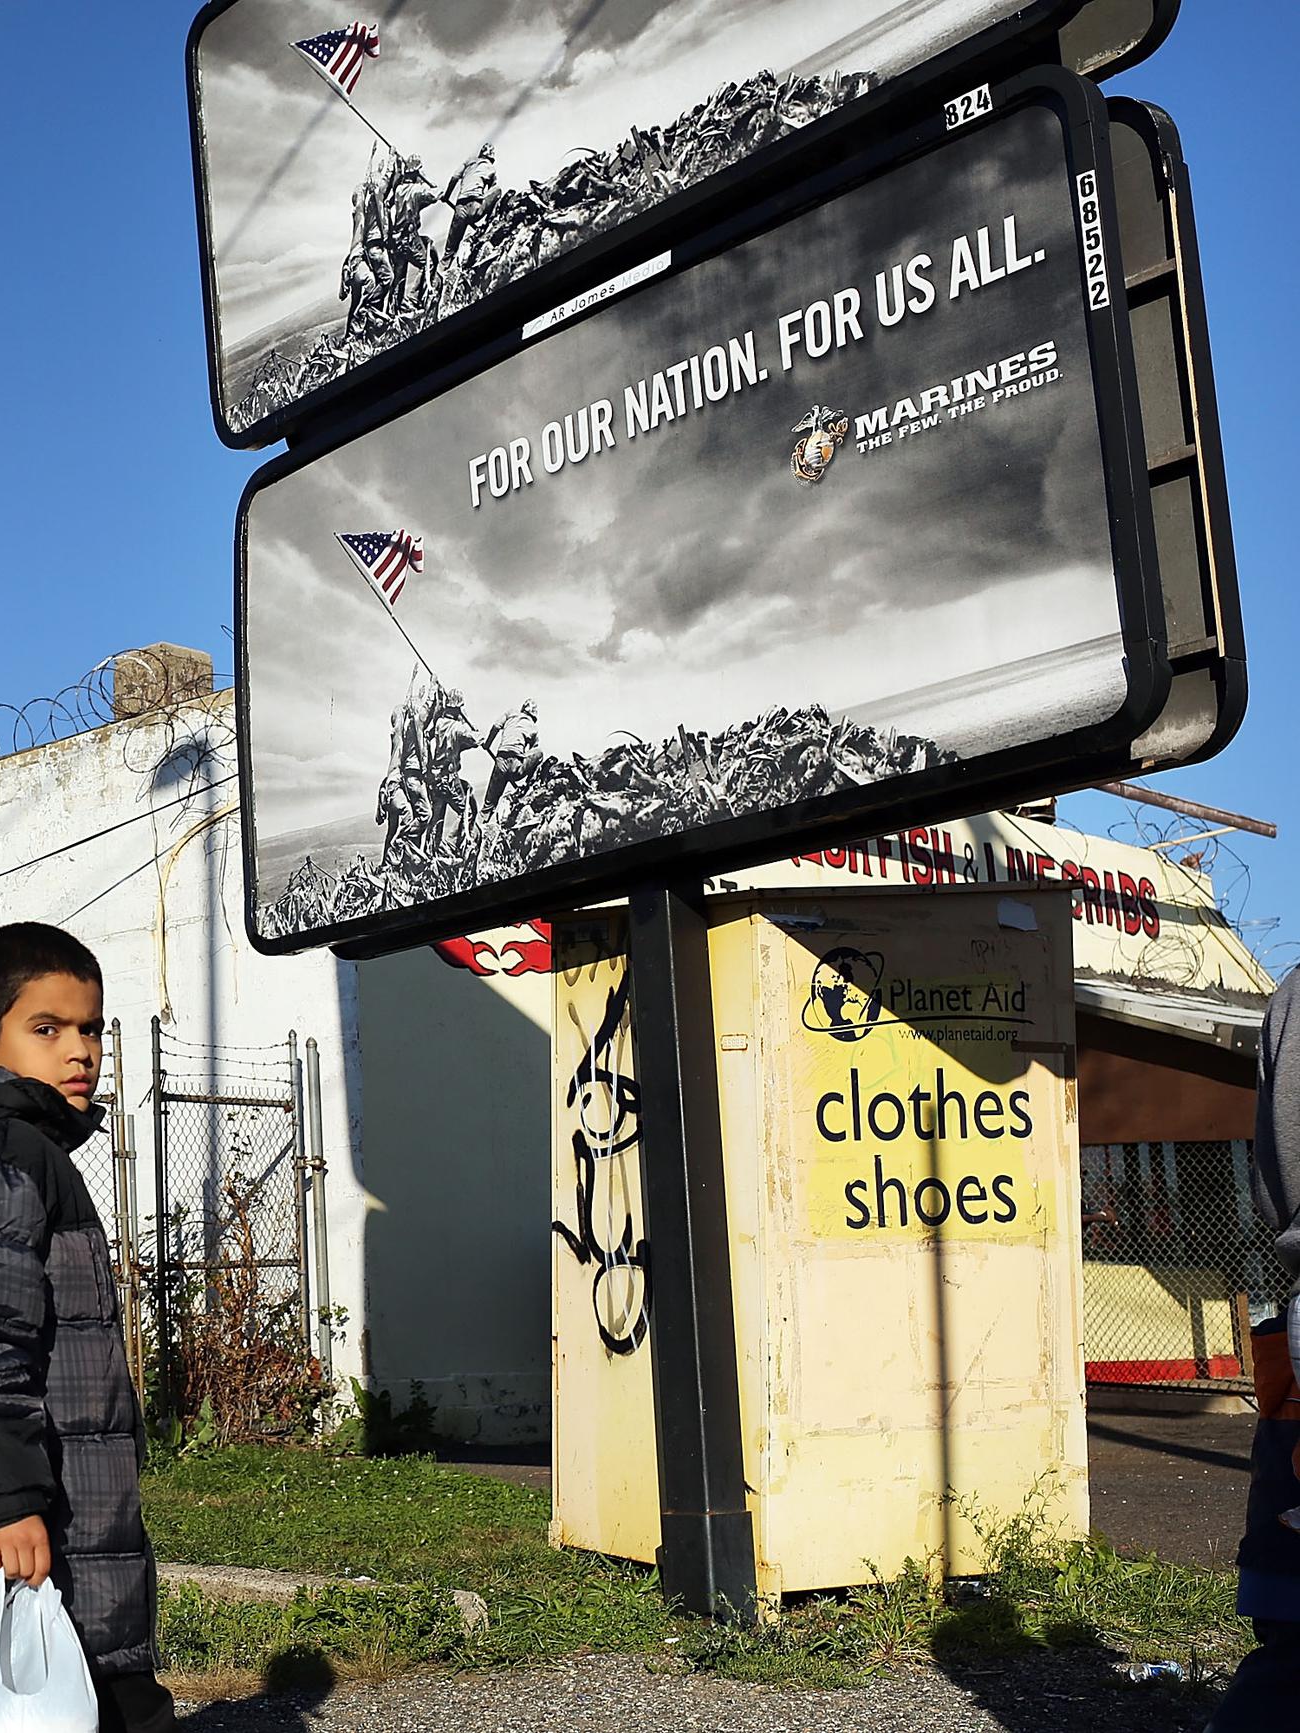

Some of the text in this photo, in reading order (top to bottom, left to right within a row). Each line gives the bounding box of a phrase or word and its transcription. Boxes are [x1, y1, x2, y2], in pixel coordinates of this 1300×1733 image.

[944, 89, 991, 127] 824
[1079, 174, 1107, 306] 68522
[550, 307, 565, 323] AR
[571, 283, 616, 312] James
[468, 214, 1046, 509] FOR OUR NATION. FOR US ALL.
[854, 340, 1058, 440] MARINES
[856, 367, 1064, 454] THE FEW. THE PROUD.
[962, 843, 979, 883] &
[890, 978, 1026, 1012] Planet Aid
[899, 1024, 1018, 1046] www.planetaid.org
[816, 1067, 1033, 1142] clothes
[844, 1154, 1018, 1230] shoes
